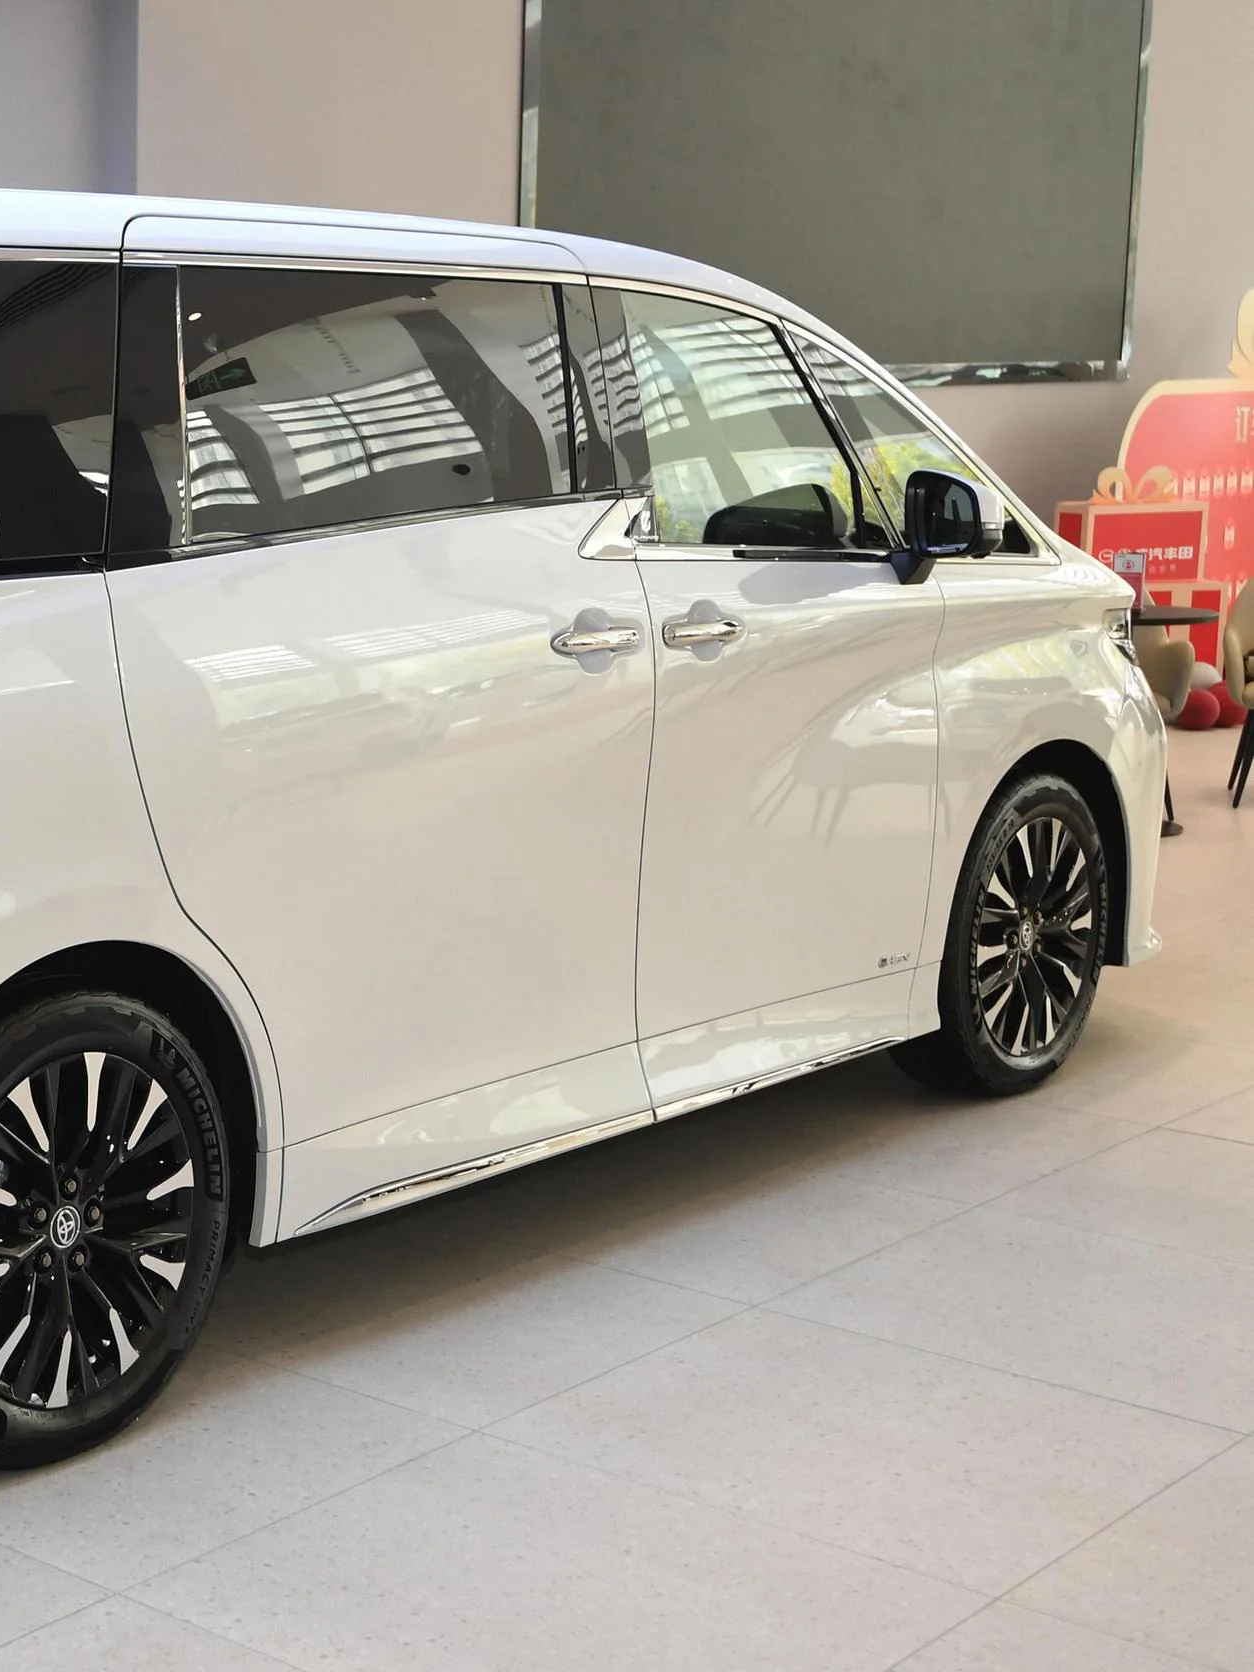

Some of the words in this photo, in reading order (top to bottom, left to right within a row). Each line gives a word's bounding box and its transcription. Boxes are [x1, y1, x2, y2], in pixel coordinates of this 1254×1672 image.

[1235, 406, 1254, 443] 订
[175, 1067, 223, 1196] MICHELIN
[197, 1218, 221, 1296] PRIMACY
